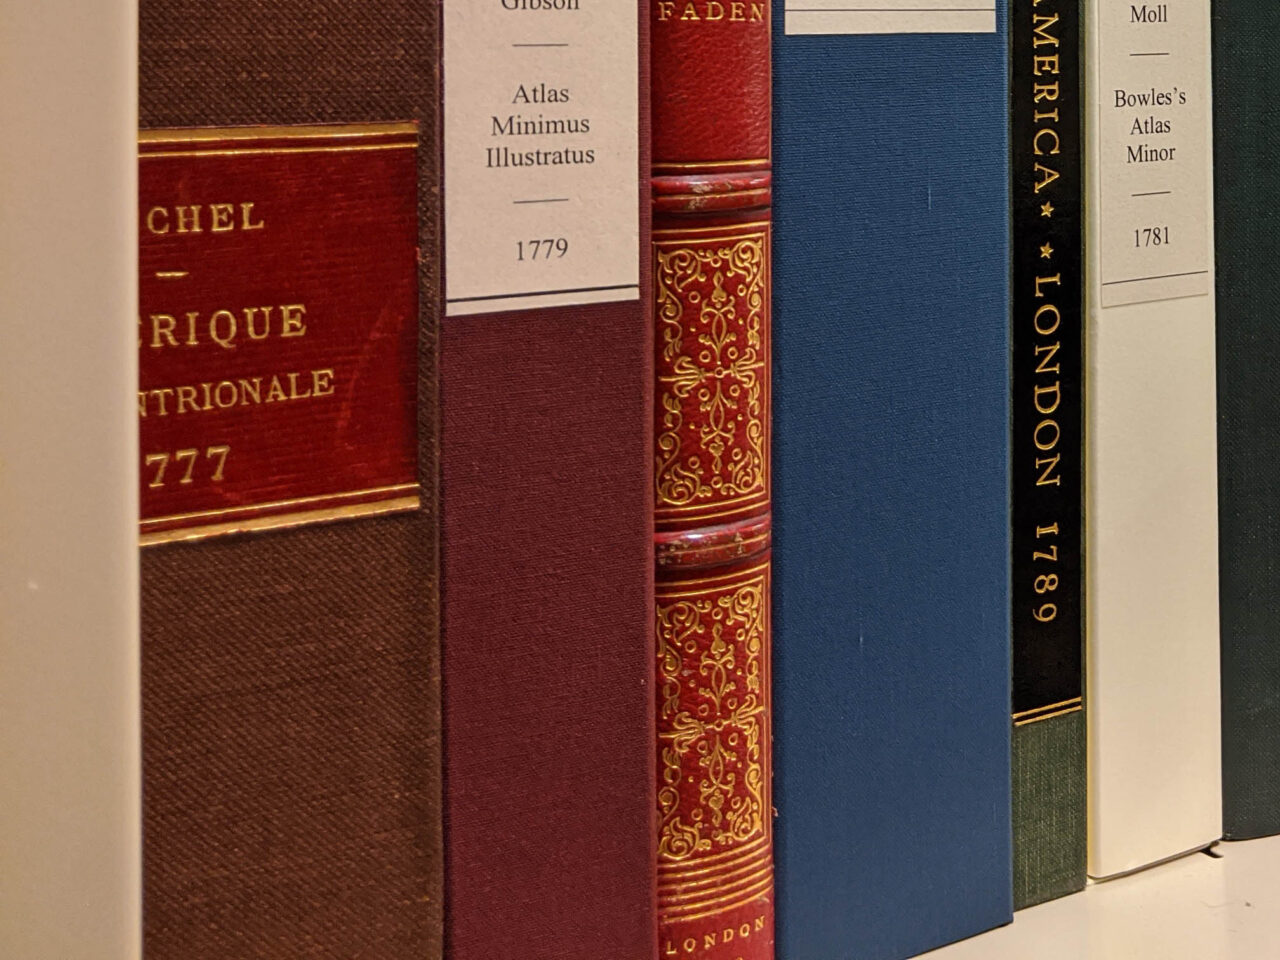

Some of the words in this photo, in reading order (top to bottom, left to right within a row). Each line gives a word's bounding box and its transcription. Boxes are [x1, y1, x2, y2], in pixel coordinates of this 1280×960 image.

[658, 1, 765, 22] FADEN
[1130, 5, 1168, 24] Moll
[512, 84, 570, 104] Atlas
[1114, 86, 1187, 108] Bowles's
[491, 114, 591, 136] Minimus
[1130, 116, 1171, 136] Atlas
[485, 147, 595, 168] Illustratus
[1126, 144, 1176, 164] Minor
[147, 202, 265, 234] CHEL
[1134, 226, 1170, 248] 1781
[516, 238, 569, 261] 1779
[138, 304, 307, 347] RIQUE
[1033, 273, 1061, 487] LONDON
[146, 446, 230, 488] 777
[1033, 522, 1059, 622] 1789
[666, 916, 765, 954] LONDON
